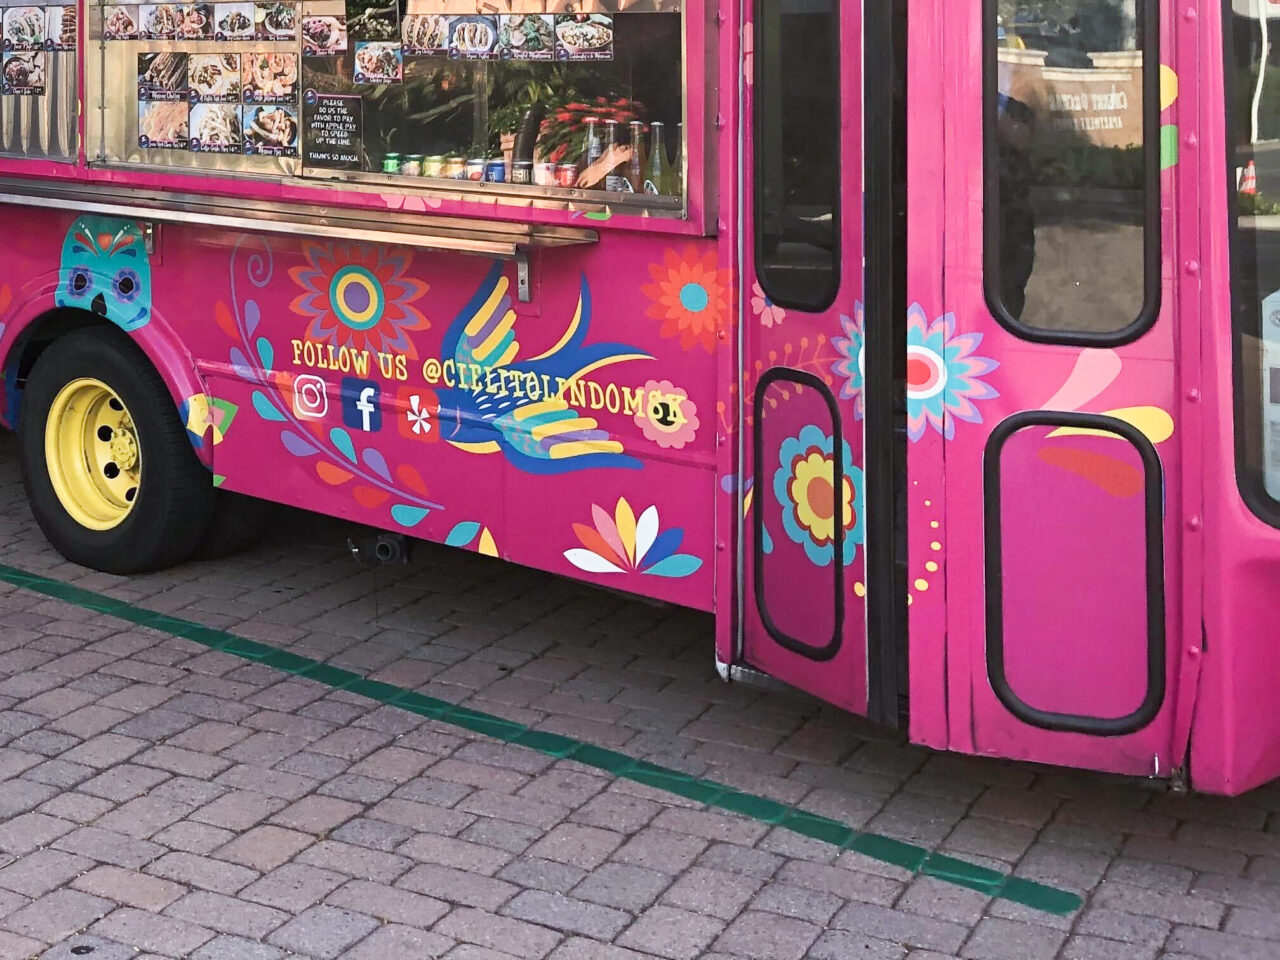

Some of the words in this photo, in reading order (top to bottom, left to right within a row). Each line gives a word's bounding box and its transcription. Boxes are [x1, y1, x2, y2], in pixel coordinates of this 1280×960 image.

[291, 339, 368, 374] FOLLOW
[378, 352, 408, 380] US
[422, 359, 688, 425] @CIELITOLINDOMSK
